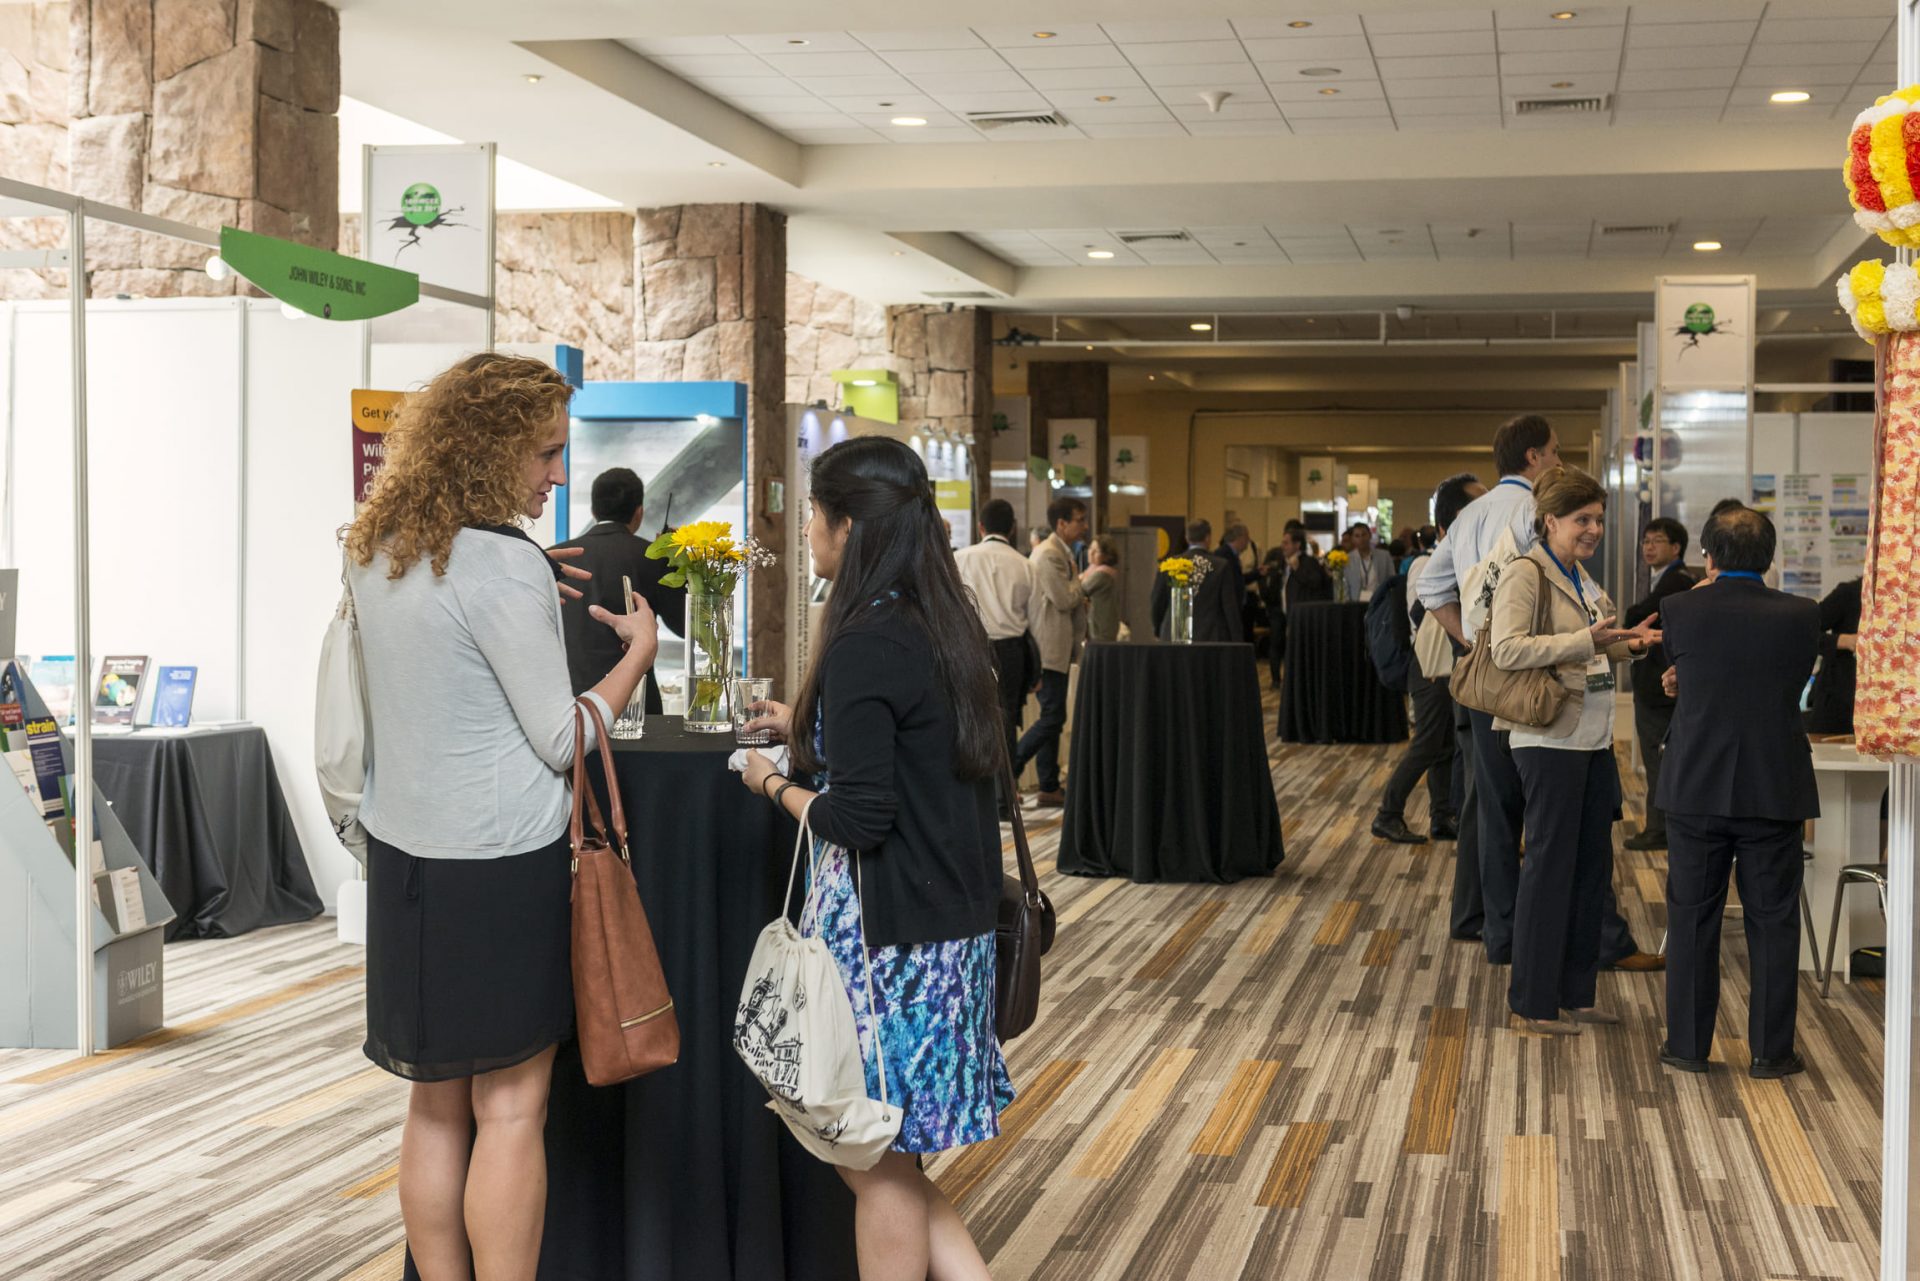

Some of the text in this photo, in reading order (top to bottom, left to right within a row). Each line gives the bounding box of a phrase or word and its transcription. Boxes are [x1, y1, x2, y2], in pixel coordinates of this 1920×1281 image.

[289, 266, 307, 283] JOHN
[308, 270, 328, 287] WILEY
[329, 274, 335, 289] &
[361, 406, 380, 418] Get
[26, 718, 57, 735] strain
[127, 961, 157, 990] WILEY
